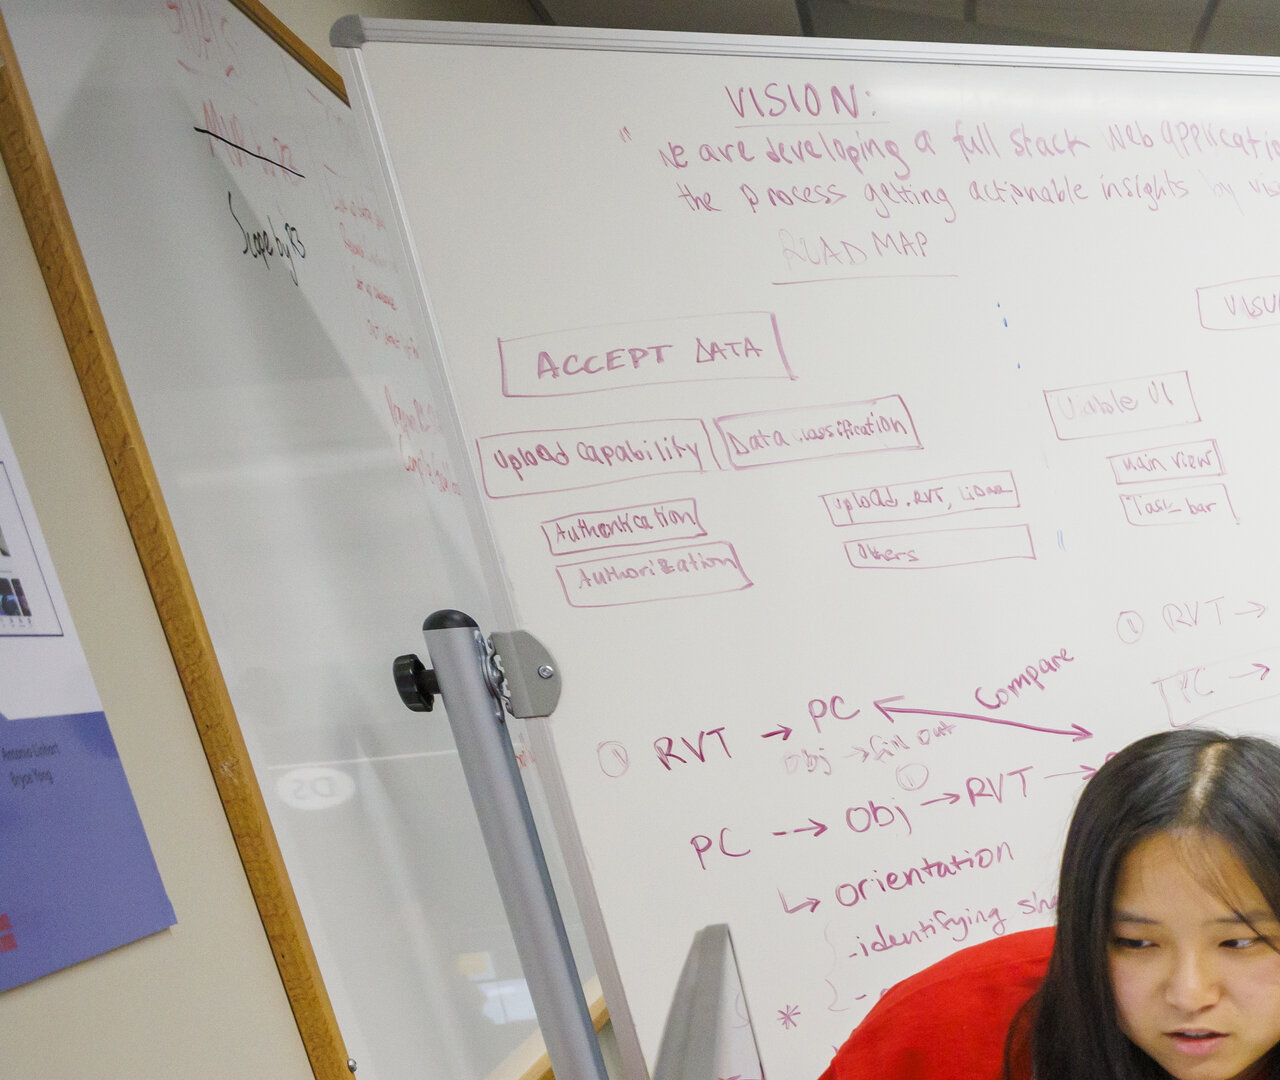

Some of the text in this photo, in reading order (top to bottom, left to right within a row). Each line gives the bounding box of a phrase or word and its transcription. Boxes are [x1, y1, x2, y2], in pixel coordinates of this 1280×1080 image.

[725, 82, 878, 119] VISION:
[701, 140, 754, 163] are
[765, 130, 912, 181] developing
[915, 129, 934, 154] a
[952, 121, 1000, 161] full
[677, 183, 722, 213] the
[745, 183, 847, 213] process
[863, 182, 957, 224] getting
[969, 174, 1089, 204] actionable
[1101, 171, 1190, 213] insights
[536, 337, 764, 380] ACCEPT DATA
[727, 427, 789, 456] Data
[555, 506, 698, 544] Authentication
[653, 727, 732, 771] RVT
[965, 765, 1035, 807] RVT
